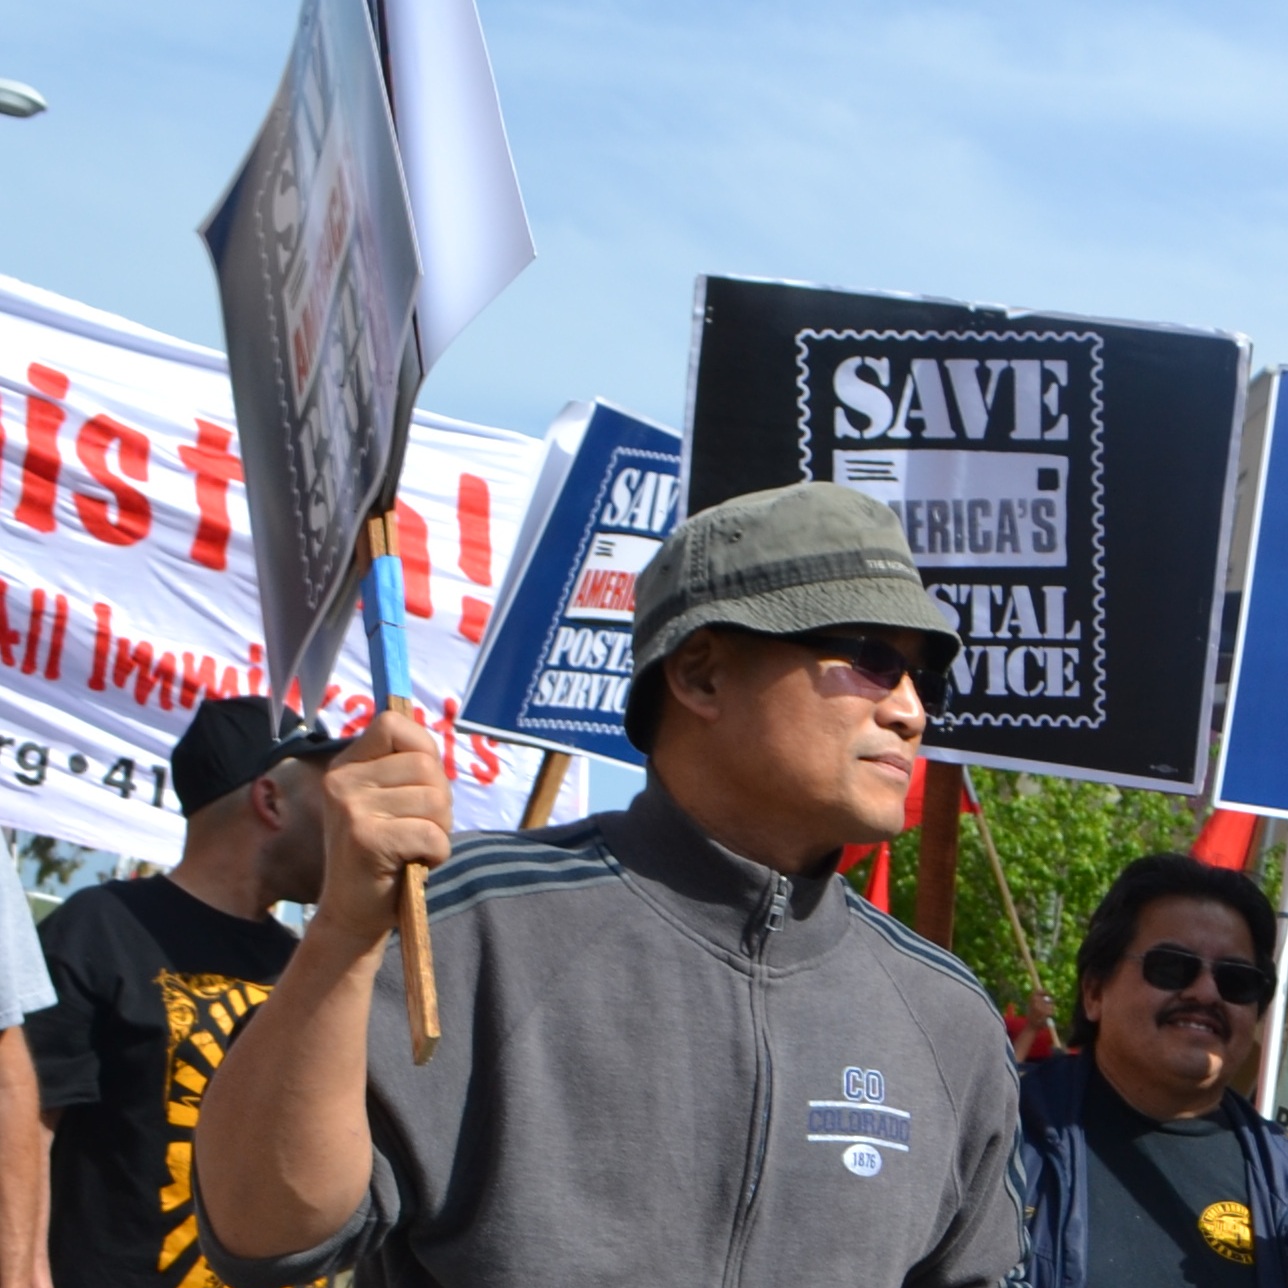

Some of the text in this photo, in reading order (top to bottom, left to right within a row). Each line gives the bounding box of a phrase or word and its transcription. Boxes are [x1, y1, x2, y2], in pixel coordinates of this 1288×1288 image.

[832, 356, 1069, 440] SAVE
[601, 467, 681, 532] SAV
[889, 498, 1058, 554] ERICA'S
[574, 570, 636, 612] AMERI
[926, 583, 1081, 640] STAL
[547, 627, 633, 675] POST
[951, 646, 1081, 697] VICE
[533, 669, 632, 714] SERVIC
[844, 1066, 884, 1104] CO
[807, 1109, 912, 1142] COLORADO
[853, 1152, 877, 1170] 1876
